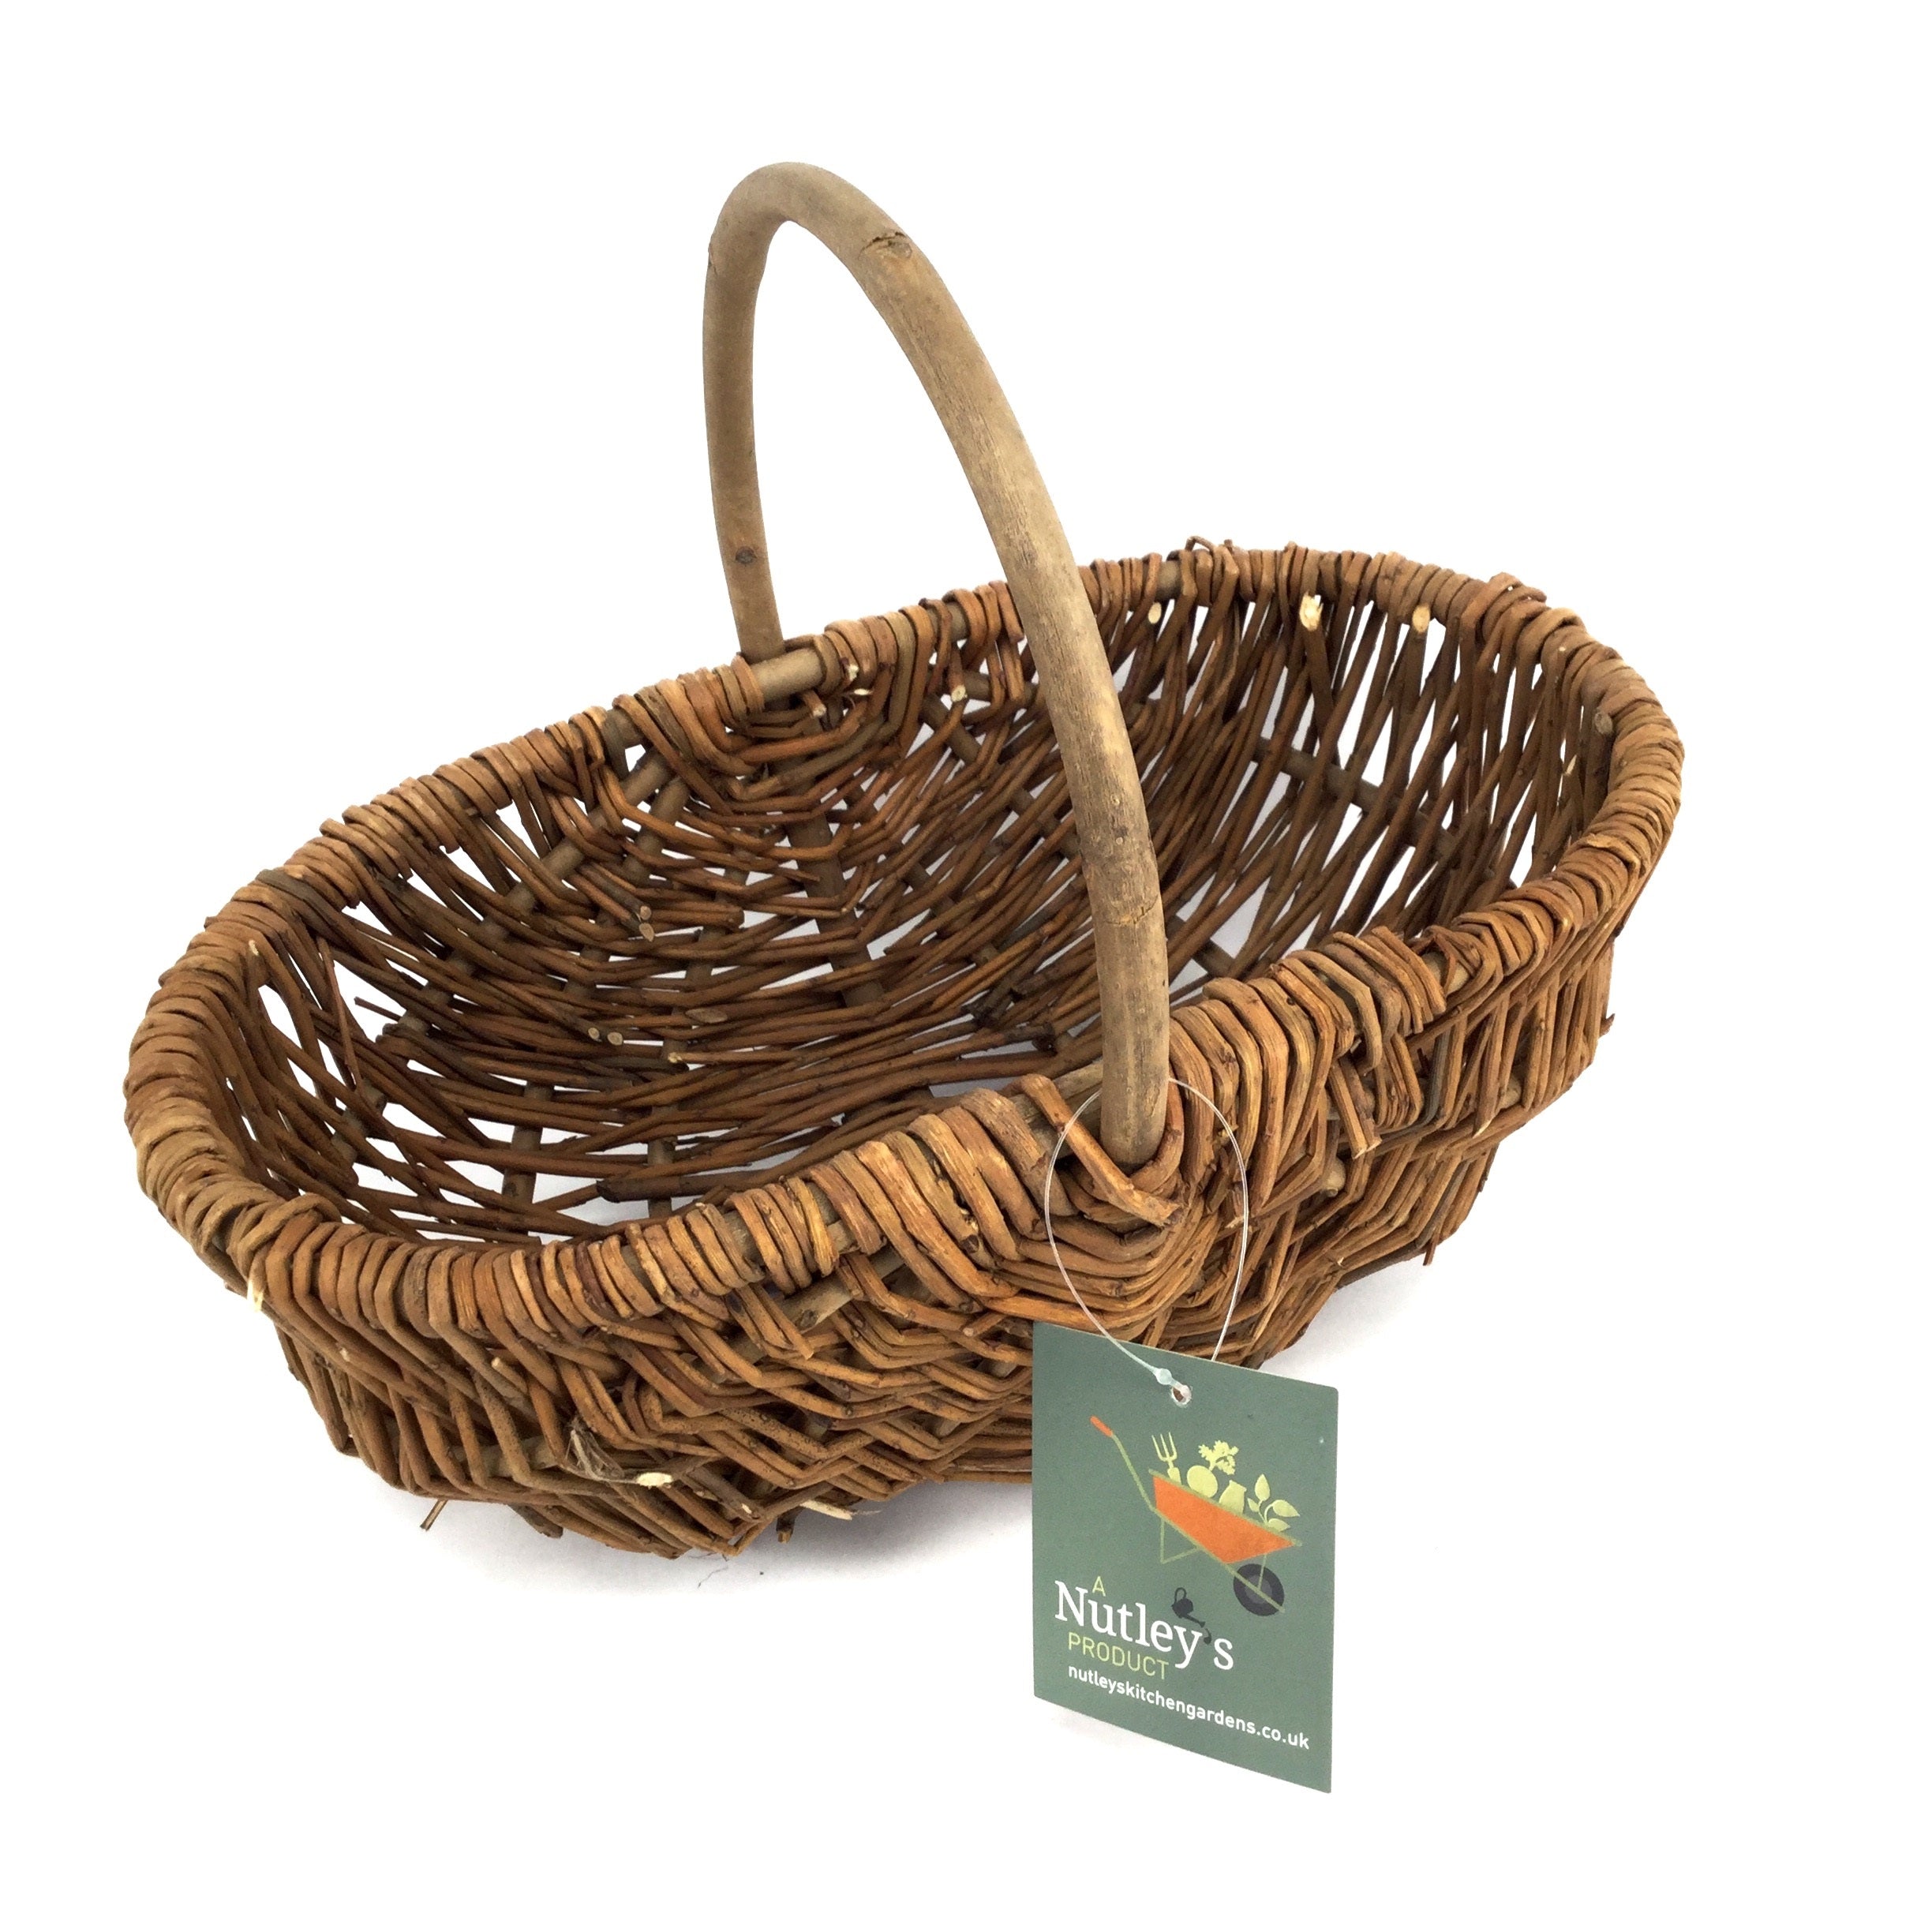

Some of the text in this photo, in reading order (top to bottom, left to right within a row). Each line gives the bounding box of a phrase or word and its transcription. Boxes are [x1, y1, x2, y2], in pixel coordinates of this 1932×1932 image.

[1091, 1575, 1106, 1597] A
[1054, 1580, 1234, 1670] Nutley's
[1068, 1631, 1169, 1679] PRODUCT
[1068, 1665, 1309, 1750] nutleyskitchengardens.co.uk
